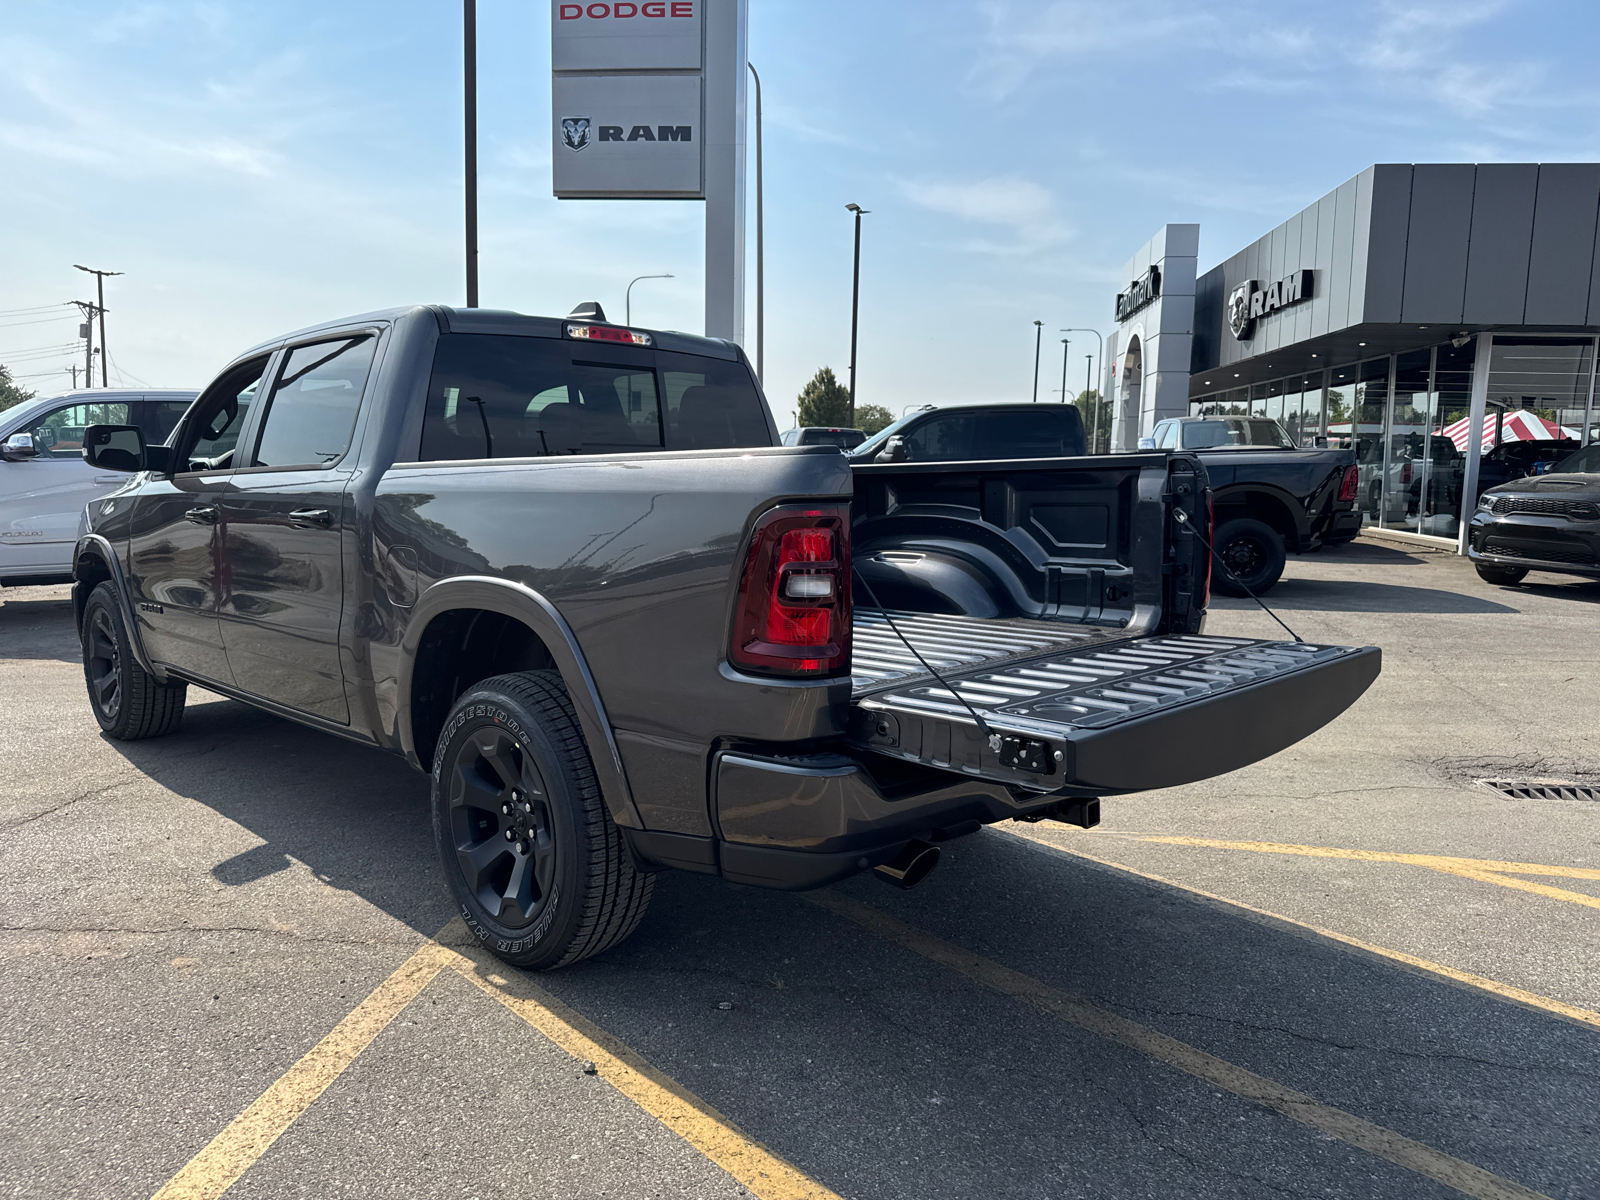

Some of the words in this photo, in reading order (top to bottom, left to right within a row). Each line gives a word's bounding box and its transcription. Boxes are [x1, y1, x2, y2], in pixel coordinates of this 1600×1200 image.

[559, 2, 693, 20] DODGE
[598, 125, 692, 142] RAM
[1250, 269, 1314, 319] RAM
[433, 705, 531, 783] BRIDGESTONE
